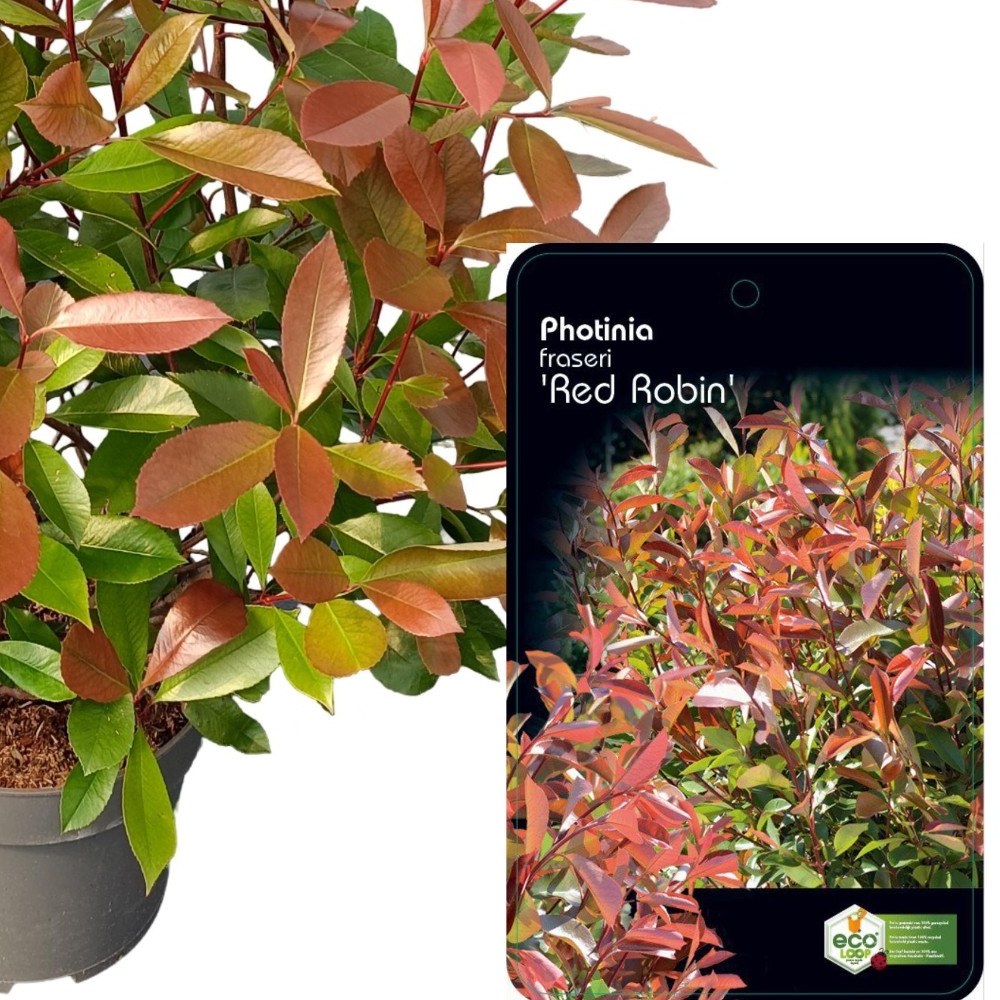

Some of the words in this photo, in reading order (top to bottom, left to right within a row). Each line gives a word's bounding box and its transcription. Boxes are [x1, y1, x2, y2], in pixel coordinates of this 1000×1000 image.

[540, 316, 653, 341] Photinia
[540, 348, 611, 367] fraseri
[541, 373, 615, 404] 'Red
[632, 373, 734, 404] Robin'
[833, 933, 877, 949] eco
[840, 949, 871, 959] LOOP
